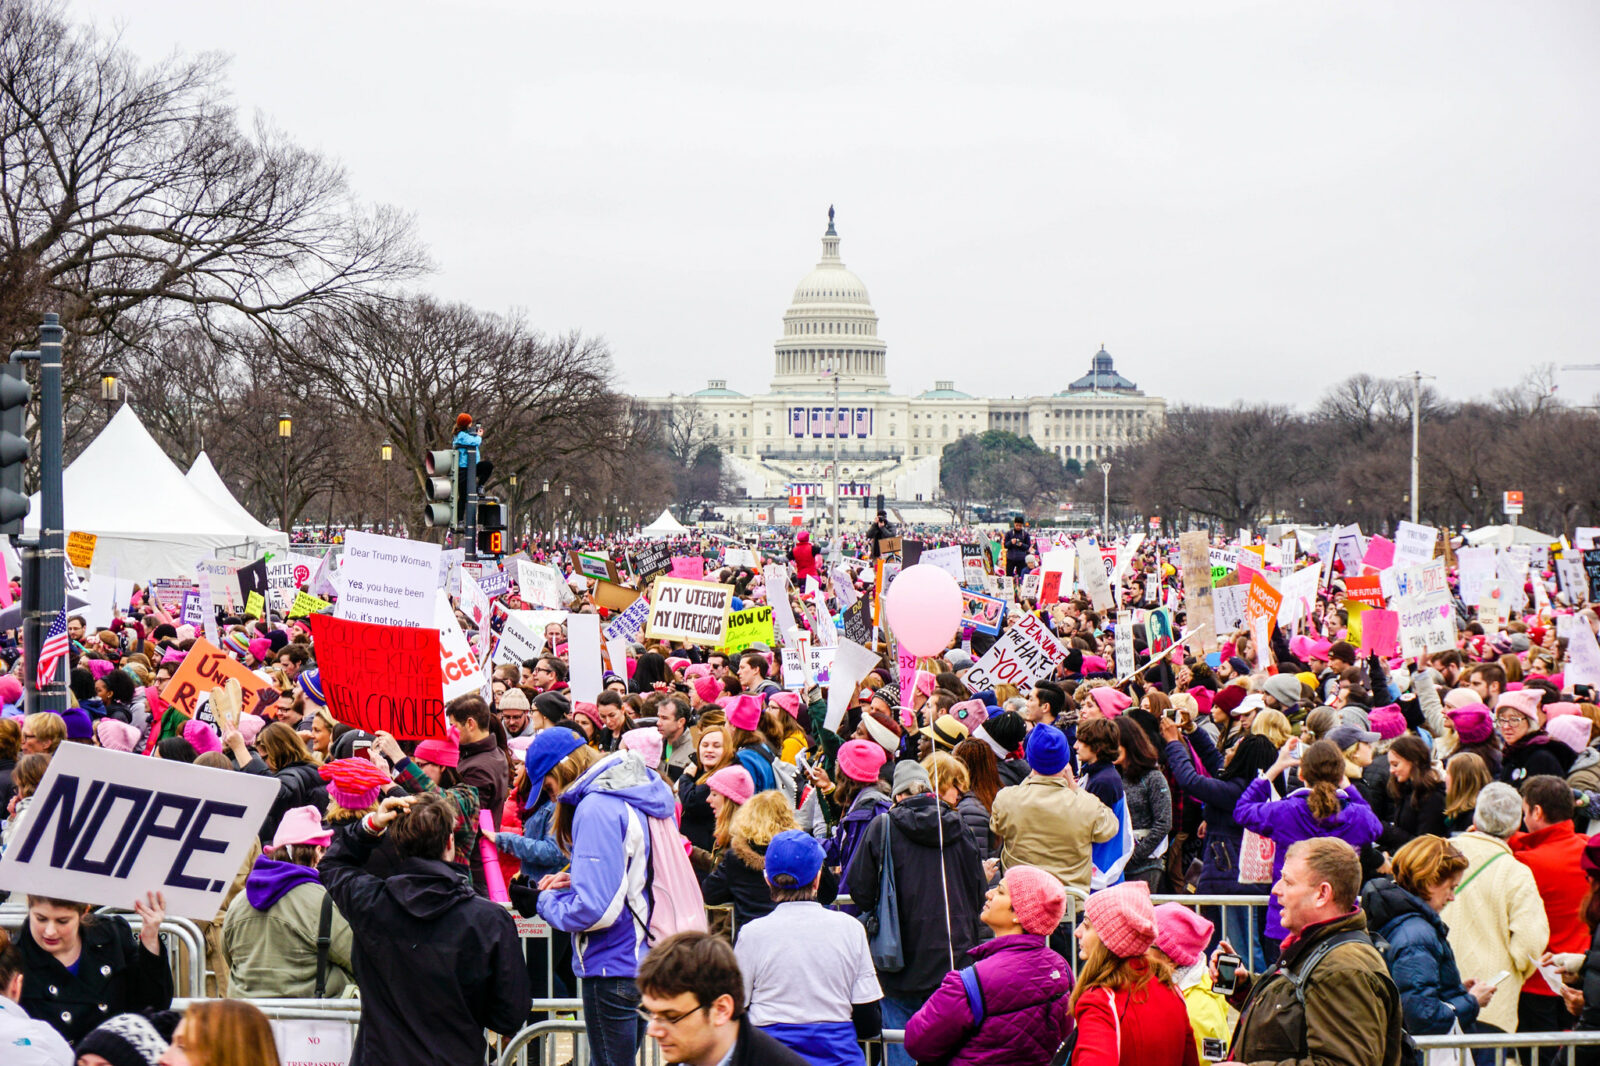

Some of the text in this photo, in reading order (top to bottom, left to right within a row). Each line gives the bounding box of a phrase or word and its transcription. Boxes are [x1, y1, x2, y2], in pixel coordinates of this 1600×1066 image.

[491, 532, 502, 552] 13
[350, 546, 432, 569] Dear Trump Woman,
[637, 542, 666, 560] WOMEN WHO
[642, 552, 664, 564] BEHAVE
[1224, 554, 1236, 563] ME
[268, 564, 293, 576] WHITE
[658, 558, 671, 569] MAKE
[268, 577, 294, 589] SILENCE
[478, 574, 508, 587] TRUST
[484, 581, 507, 593] OMEN
[1423, 567, 1444, 592] PEOPLE
[348, 580, 424, 598] Yes, you have been
[1254, 583, 1278, 611] WOMEN
[1359, 588, 1382, 596] FUTURE
[346, 594, 401, 608] brainwashed.
[660, 587, 726, 609] MY UTERUS
[629, 606, 646, 623] MOUTH
[634, 600, 650, 614] LOUD
[757, 609, 772, 622] UP
[853, 600, 862, 614] END
[345, 610, 358, 620] No,
[360, 613, 372, 622] it's
[405, 619, 420, 628] late
[622, 612, 640, 631] WOMEN
[653, 610, 672, 627] MY
[673, 611, 722, 635] UTERIGHTS
[1402, 605, 1439, 627] Stronger
[321, 618, 428, 650] YOU COULD
[508, 626, 536, 651] CLASS ACT
[606, 627, 618, 638] MEN
[1410, 632, 1446, 649] THAN FEAR
[787, 652, 820, 660] STRER
[1008, 628, 1053, 670] THE HATE
[341, 646, 378, 674] THE
[387, 652, 435, 674] KING
[502, 653, 513, 663] BUT
[406, 675, 436, 696] THE
[366, 694, 446, 737] CONQUER
[16, 774, 248, 893] NOPE.
[308, 1037, 320, 1045] NO
